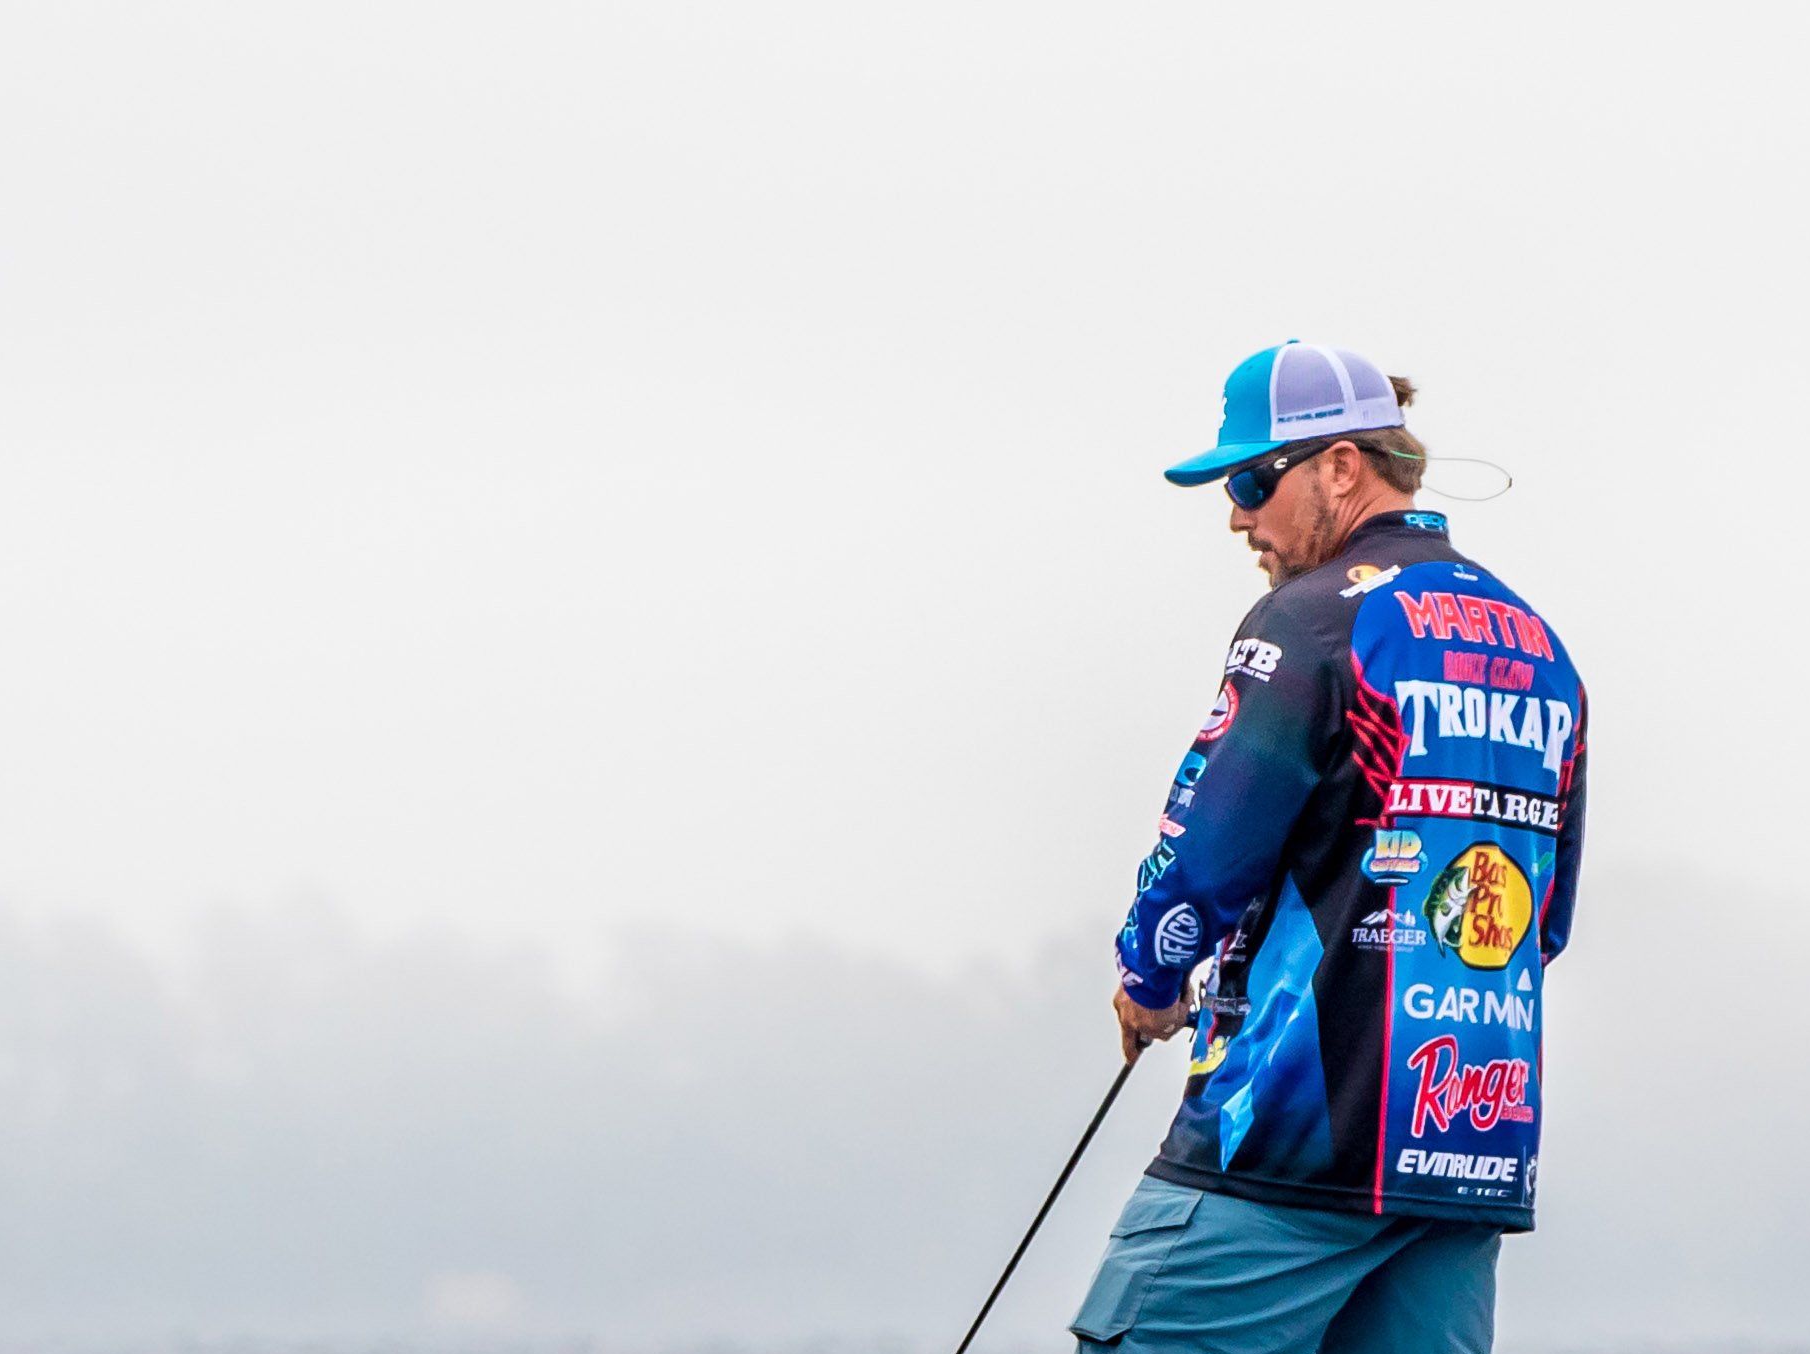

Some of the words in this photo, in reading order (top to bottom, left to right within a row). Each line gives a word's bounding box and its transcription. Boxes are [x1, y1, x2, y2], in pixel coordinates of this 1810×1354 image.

[1394, 591, 1555, 662] MARTIN
[1389, 783, 1560, 831] LIVETARGE
[1352, 928, 1427, 946] TRAEGER
[1403, 983, 1535, 1033] GARMIN
[1407, 1034, 1530, 1139] Ranger
[1396, 1148, 1518, 1182] EVINRUDE
